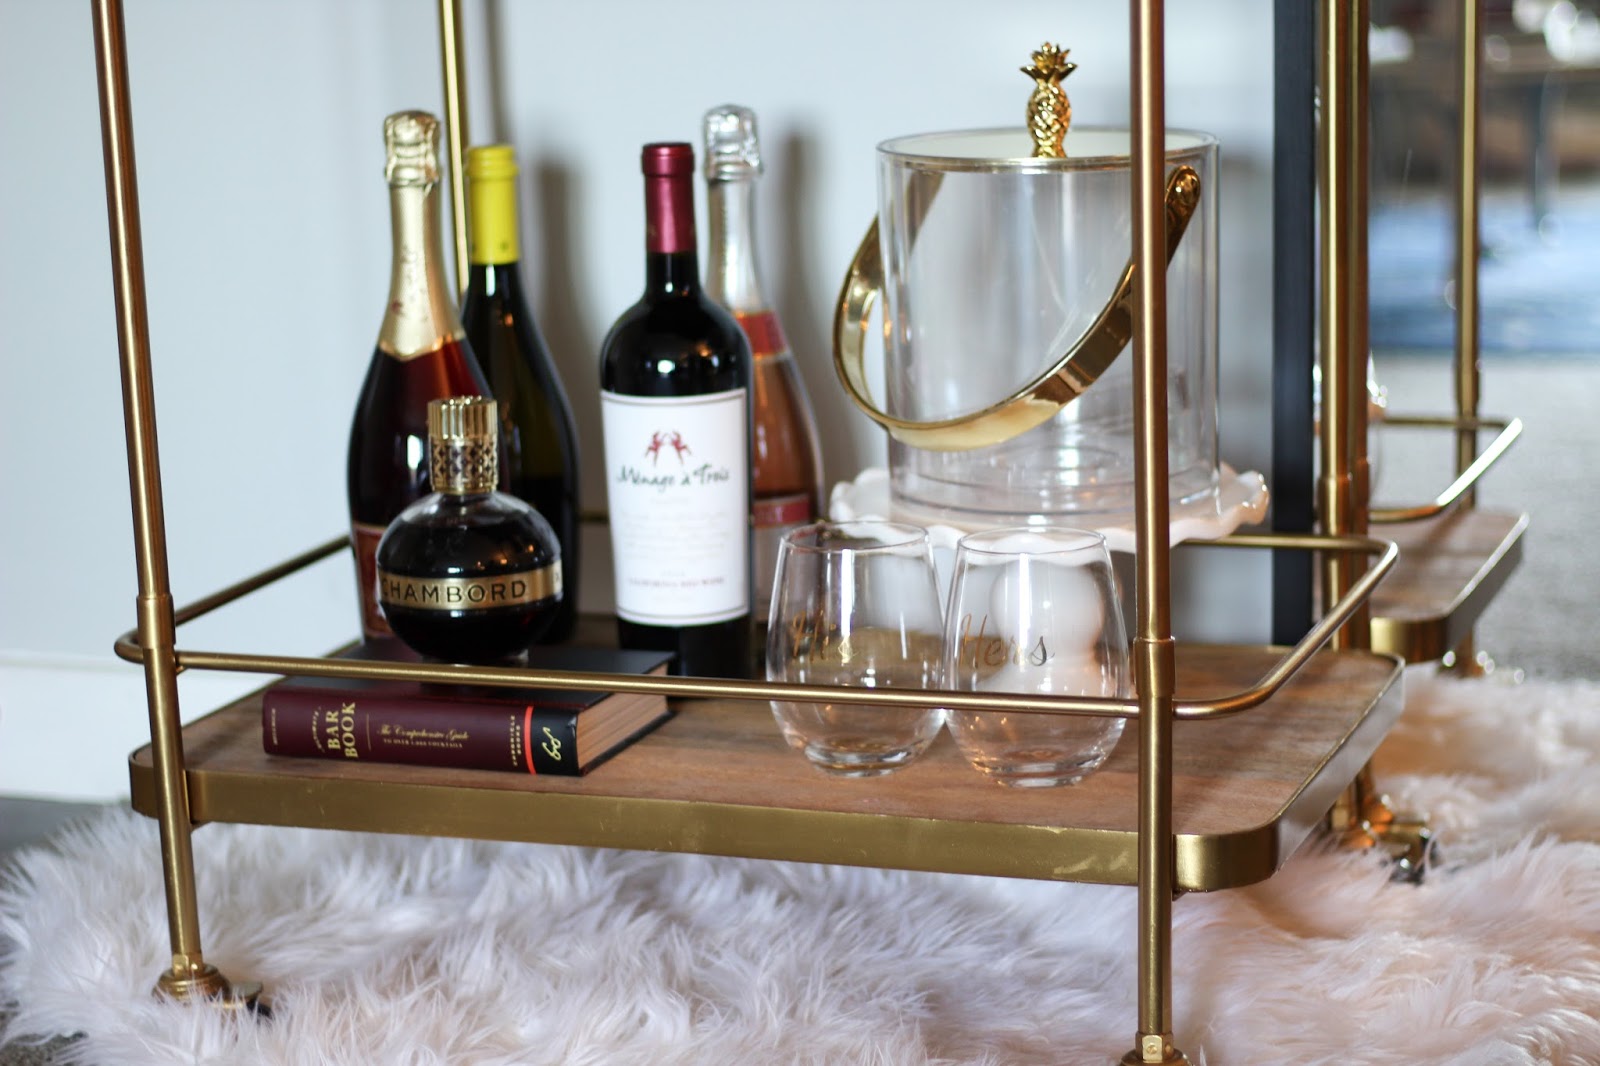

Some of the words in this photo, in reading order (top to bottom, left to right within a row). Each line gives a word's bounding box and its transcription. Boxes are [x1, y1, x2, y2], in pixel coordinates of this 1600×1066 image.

[693, 463, 730, 485] Trois
[790, 609, 858, 666] His
[959, 612, 1055, 669] Hers
[325, 710, 341, 750] BAR
[341, 701, 359, 758] BOOK
[445, 728, 470, 742] Guide
